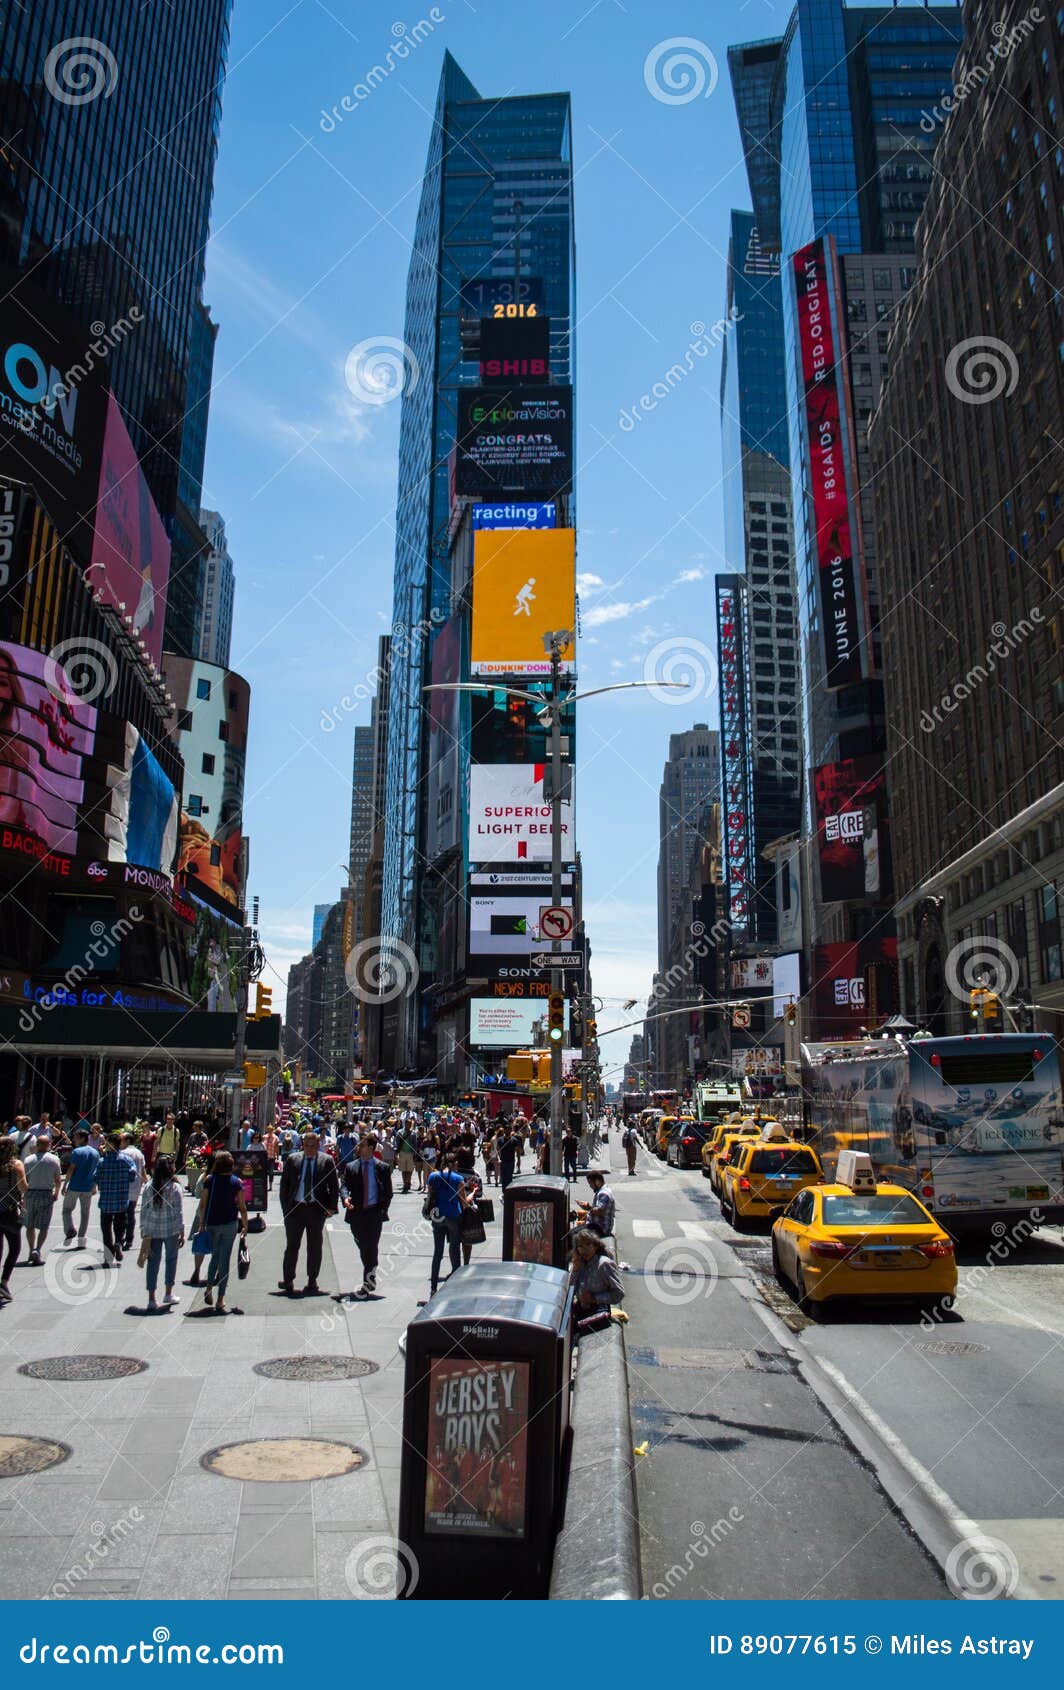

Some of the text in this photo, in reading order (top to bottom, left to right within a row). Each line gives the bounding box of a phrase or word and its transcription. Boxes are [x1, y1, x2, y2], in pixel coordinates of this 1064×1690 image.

[493, 303, 537, 318] 2016
[479, 359, 549, 377] SHIB
[472, 408, 566, 424] EploraVision
[42, 420, 83, 469] media
[476, 434, 553, 445] CONGRATS
[472, 504, 555, 521] racting T
[830, 556, 850, 660] JUNE 2016
[487, 664, 564, 673] DUNKIN' DONS
[484, 806, 552, 817] SUPERIO
[477, 823, 569, 835] LIGHT BER
[87, 864, 108, 876] abc
[537, 956, 578, 965] ONE WAY
[498, 967, 542, 977] SONY
[494, 982, 524, 996] NEWS
[81, 989, 108, 1006] for
[515, 1205, 549, 1225] JERSEY
[520, 1223, 545, 1238] BOYS
[435, 1368, 516, 1417] JERSEY
[444, 1412, 502, 1452] BOYS
